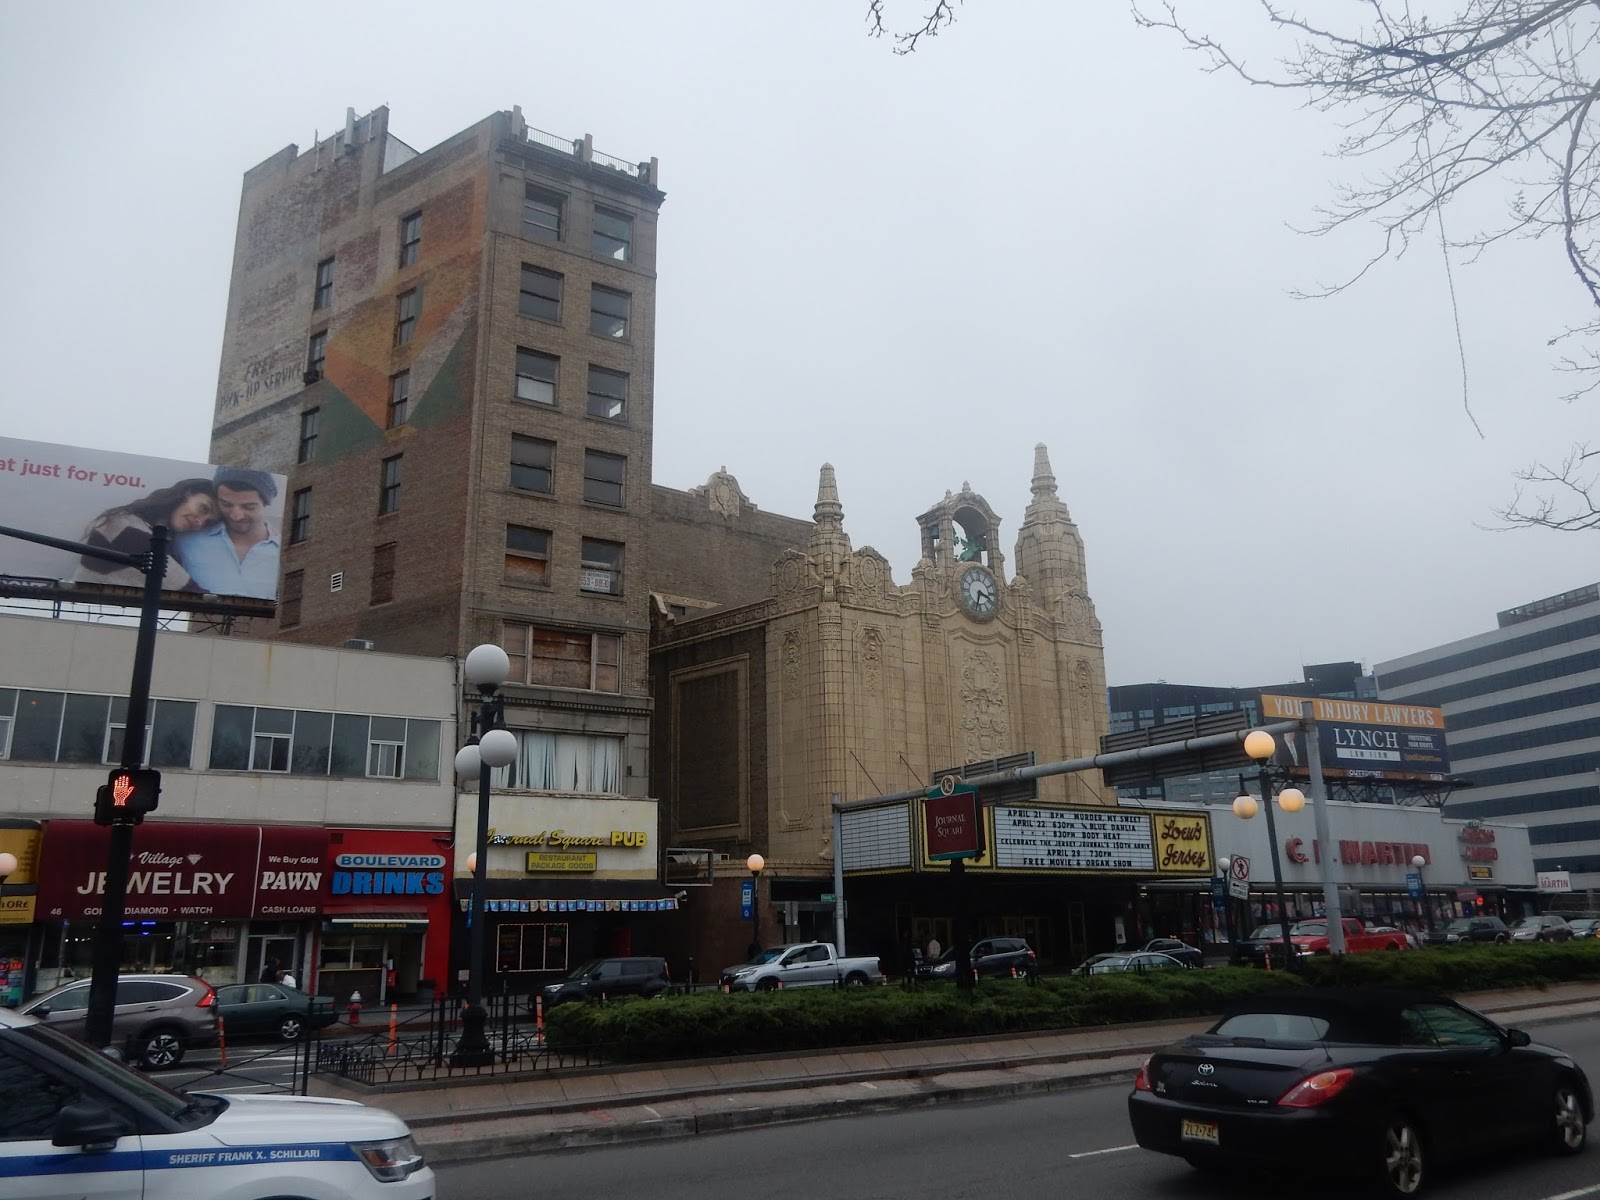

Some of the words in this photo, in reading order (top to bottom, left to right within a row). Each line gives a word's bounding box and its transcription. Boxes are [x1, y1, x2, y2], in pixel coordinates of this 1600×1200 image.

[20, 459, 61, 476] just
[67, 465, 98, 481] for
[103, 472, 146, 488] you.
[1275, 698, 1303, 717] YOU
[1320, 701, 1369, 722] INJURY
[1374, 707, 1435, 727] LAWYERS
[1334, 727, 1399, 748] LYNCH
[1007, 809, 1030, 818] APRIL
[1107, 814, 1117, 822] MY
[1120, 815, 1141, 823] SWEET
[1012, 819, 1034, 828] APRIL
[1037, 820, 1046, 828] 22
[1089, 823, 1107, 831] BLUE
[1111, 824, 1136, 832] DAHLIA
[548, 830, 603, 849] Square
[611, 831, 647, 847] PUB
[1082, 831, 1100, 839] BODY
[1103, 832, 1121, 840] HEAT
[1000, 838, 1037, 846] CELEBRATE
[1054, 840, 1077, 848] JERSEY
[138, 851, 183, 868] Village
[1047, 849, 1069, 857] APRIL
[1162, 843, 1206, 868] Jersey
[268, 856, 281, 864] We
[283, 856, 298, 865] Buy
[300, 856, 319, 864] Gold
[341, 856, 441, 867] BOULEVARD
[1023, 858, 1046, 866] FREE
[1050, 858, 1072, 866] MOVIE
[1086, 859, 1110, 867] ORGAN
[260, 871, 322, 891] PAWN
[331, 871, 445, 895] DRINKS
[1540, 880, 1568, 889] MARTIN
[124, 907, 169, 915] DIAMOND
[180, 906, 213, 914] WATCH
[287, 906, 316, 914] LOANS
[169, 1153, 216, 1164] SHERIFF
[218, 1151, 252, 1162] FRANK
[256, 1151, 266, 1160] X.
[270, 1150, 320, 1159] SCHILLARI
